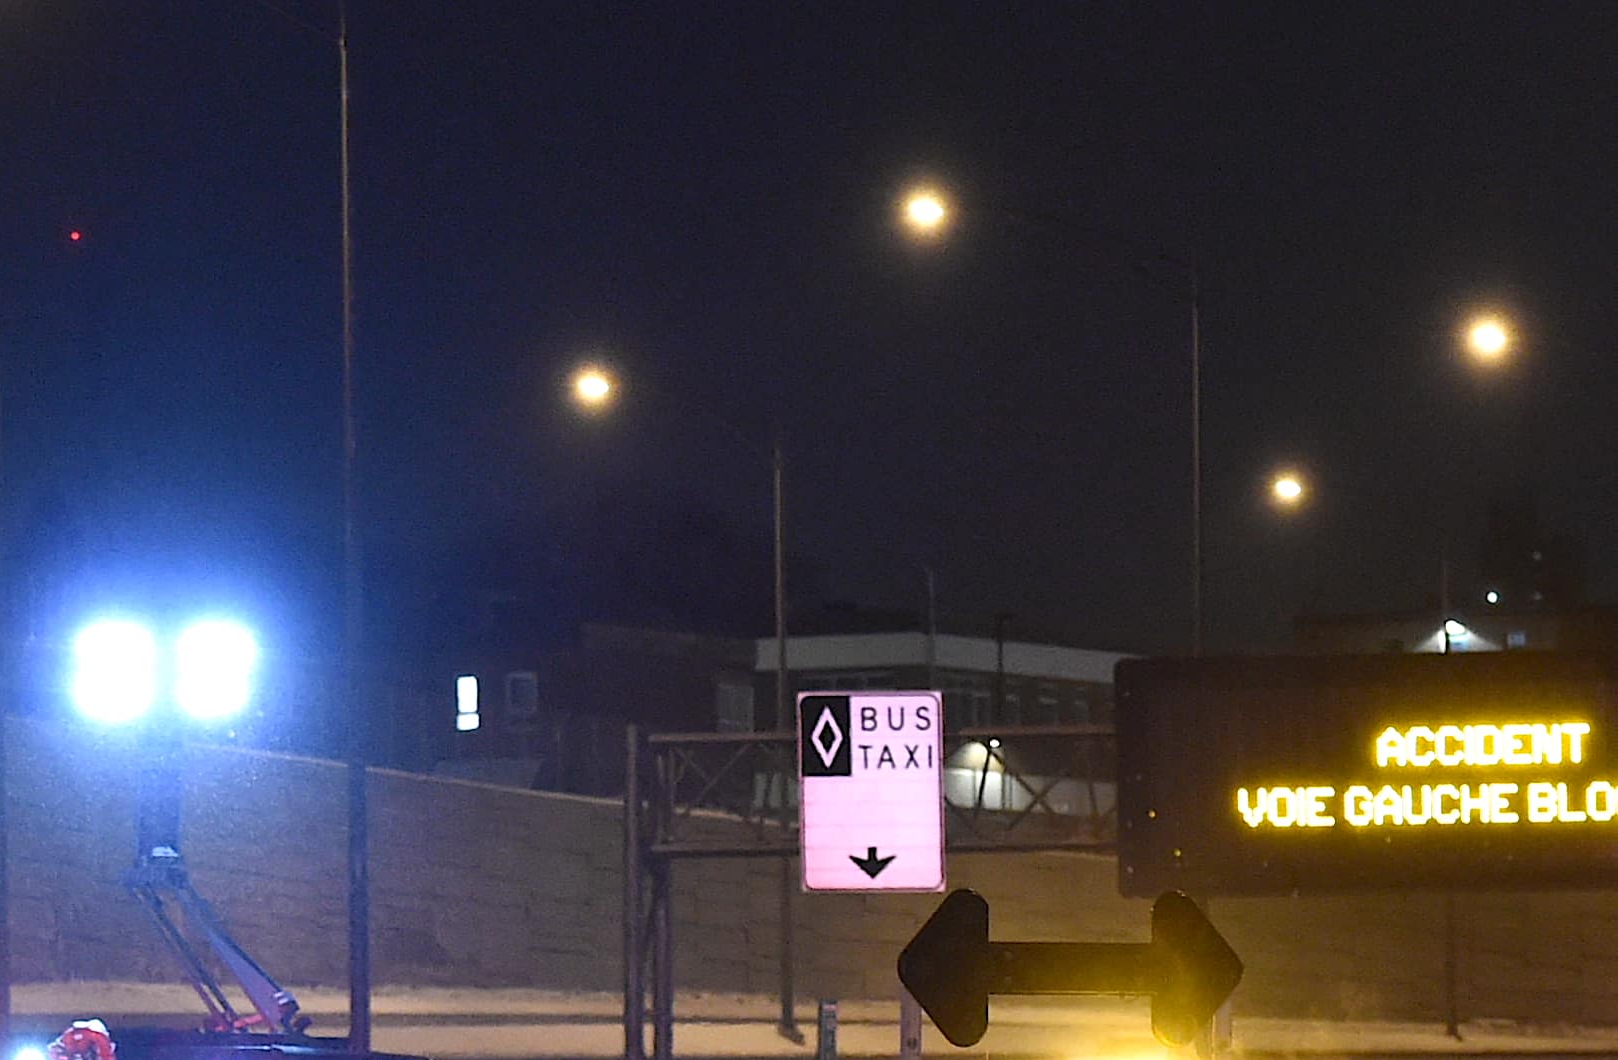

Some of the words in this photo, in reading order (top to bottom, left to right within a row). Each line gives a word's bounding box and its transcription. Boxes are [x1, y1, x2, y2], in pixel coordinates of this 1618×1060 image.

[861, 706, 931, 731] BUS
[858, 745, 932, 769] TAXI
[1375, 722, 1591, 767] ACCIDENT
[1237, 787, 1336, 827] VOIE
[1343, 783, 1520, 826] GAUCHE
